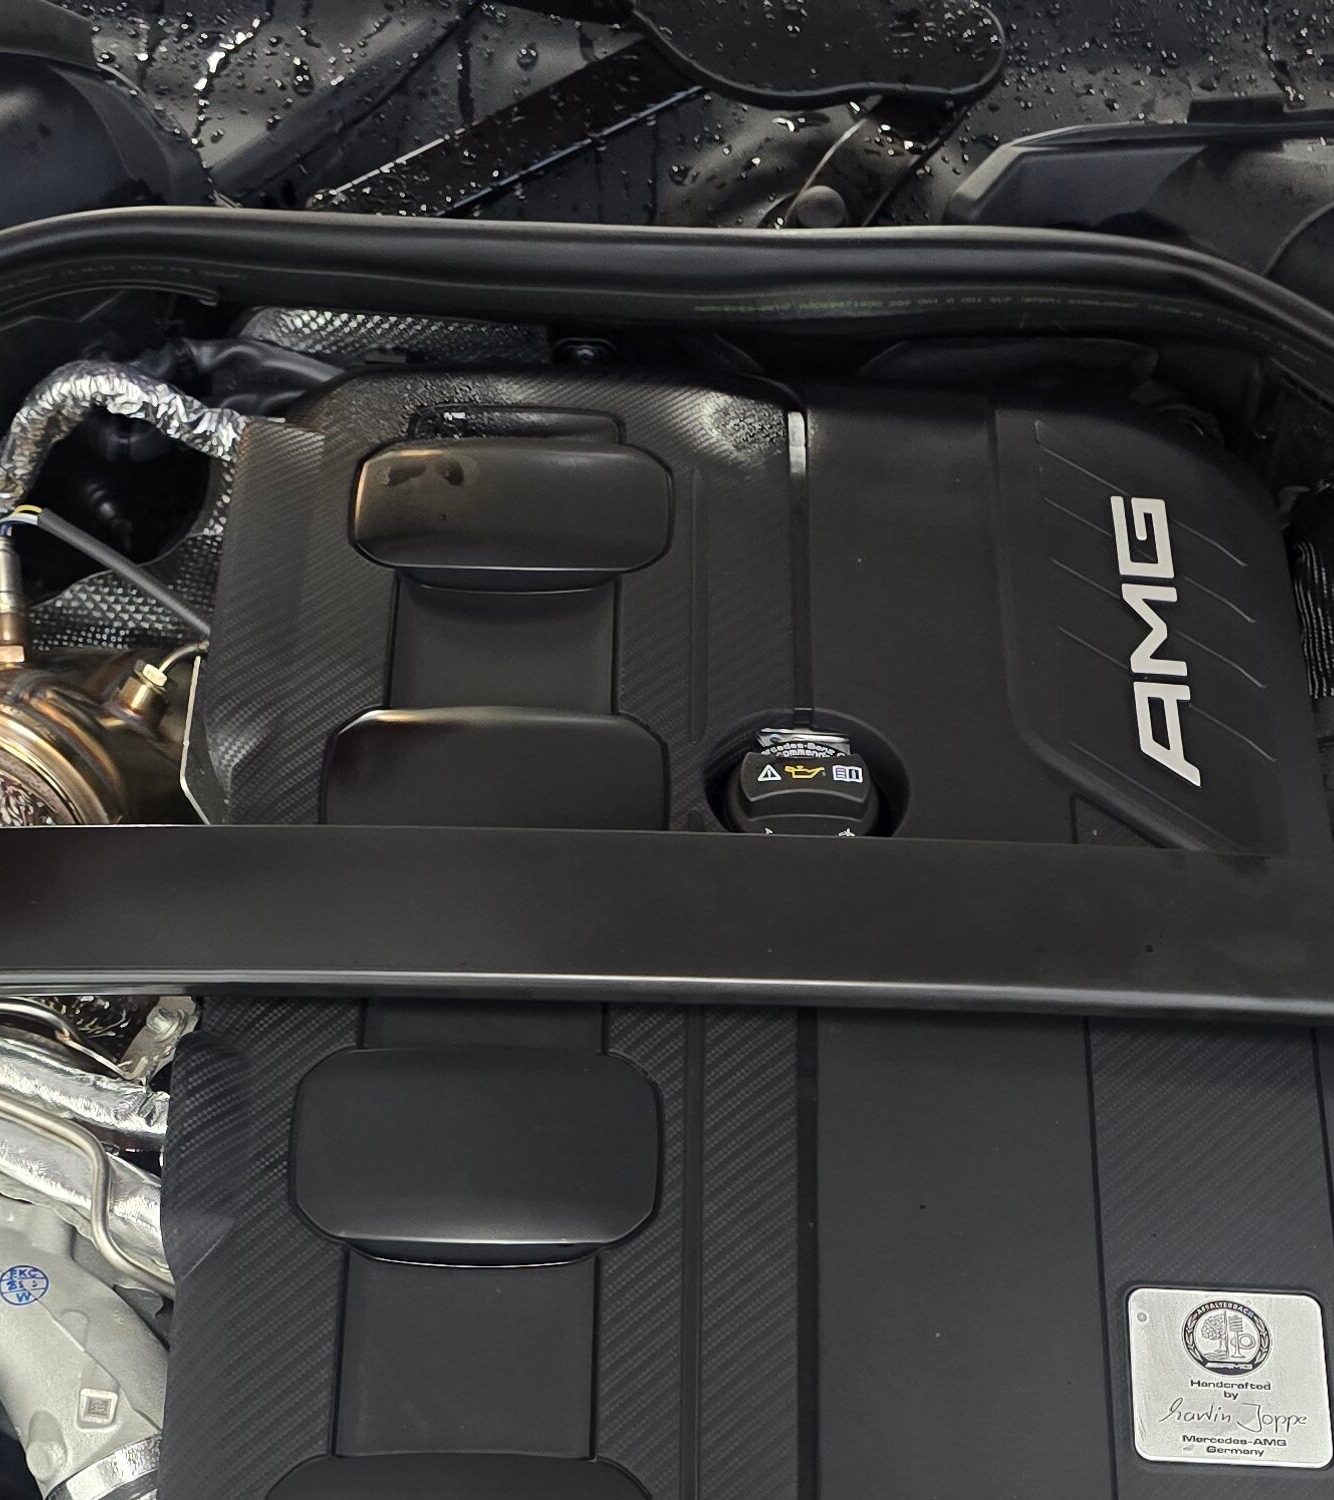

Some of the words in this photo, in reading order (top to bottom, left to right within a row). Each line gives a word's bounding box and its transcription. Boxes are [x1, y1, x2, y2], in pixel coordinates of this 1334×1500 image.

[1110, 495, 1201, 787] AMG
[1190, 1379, 1272, 1391] Handcrafted
[1223, 1391, 1239, 1400] by
[1182, 1434, 1288, 1447] Mercedes-AMG
[1206, 1446, 1265, 1457] Germany
